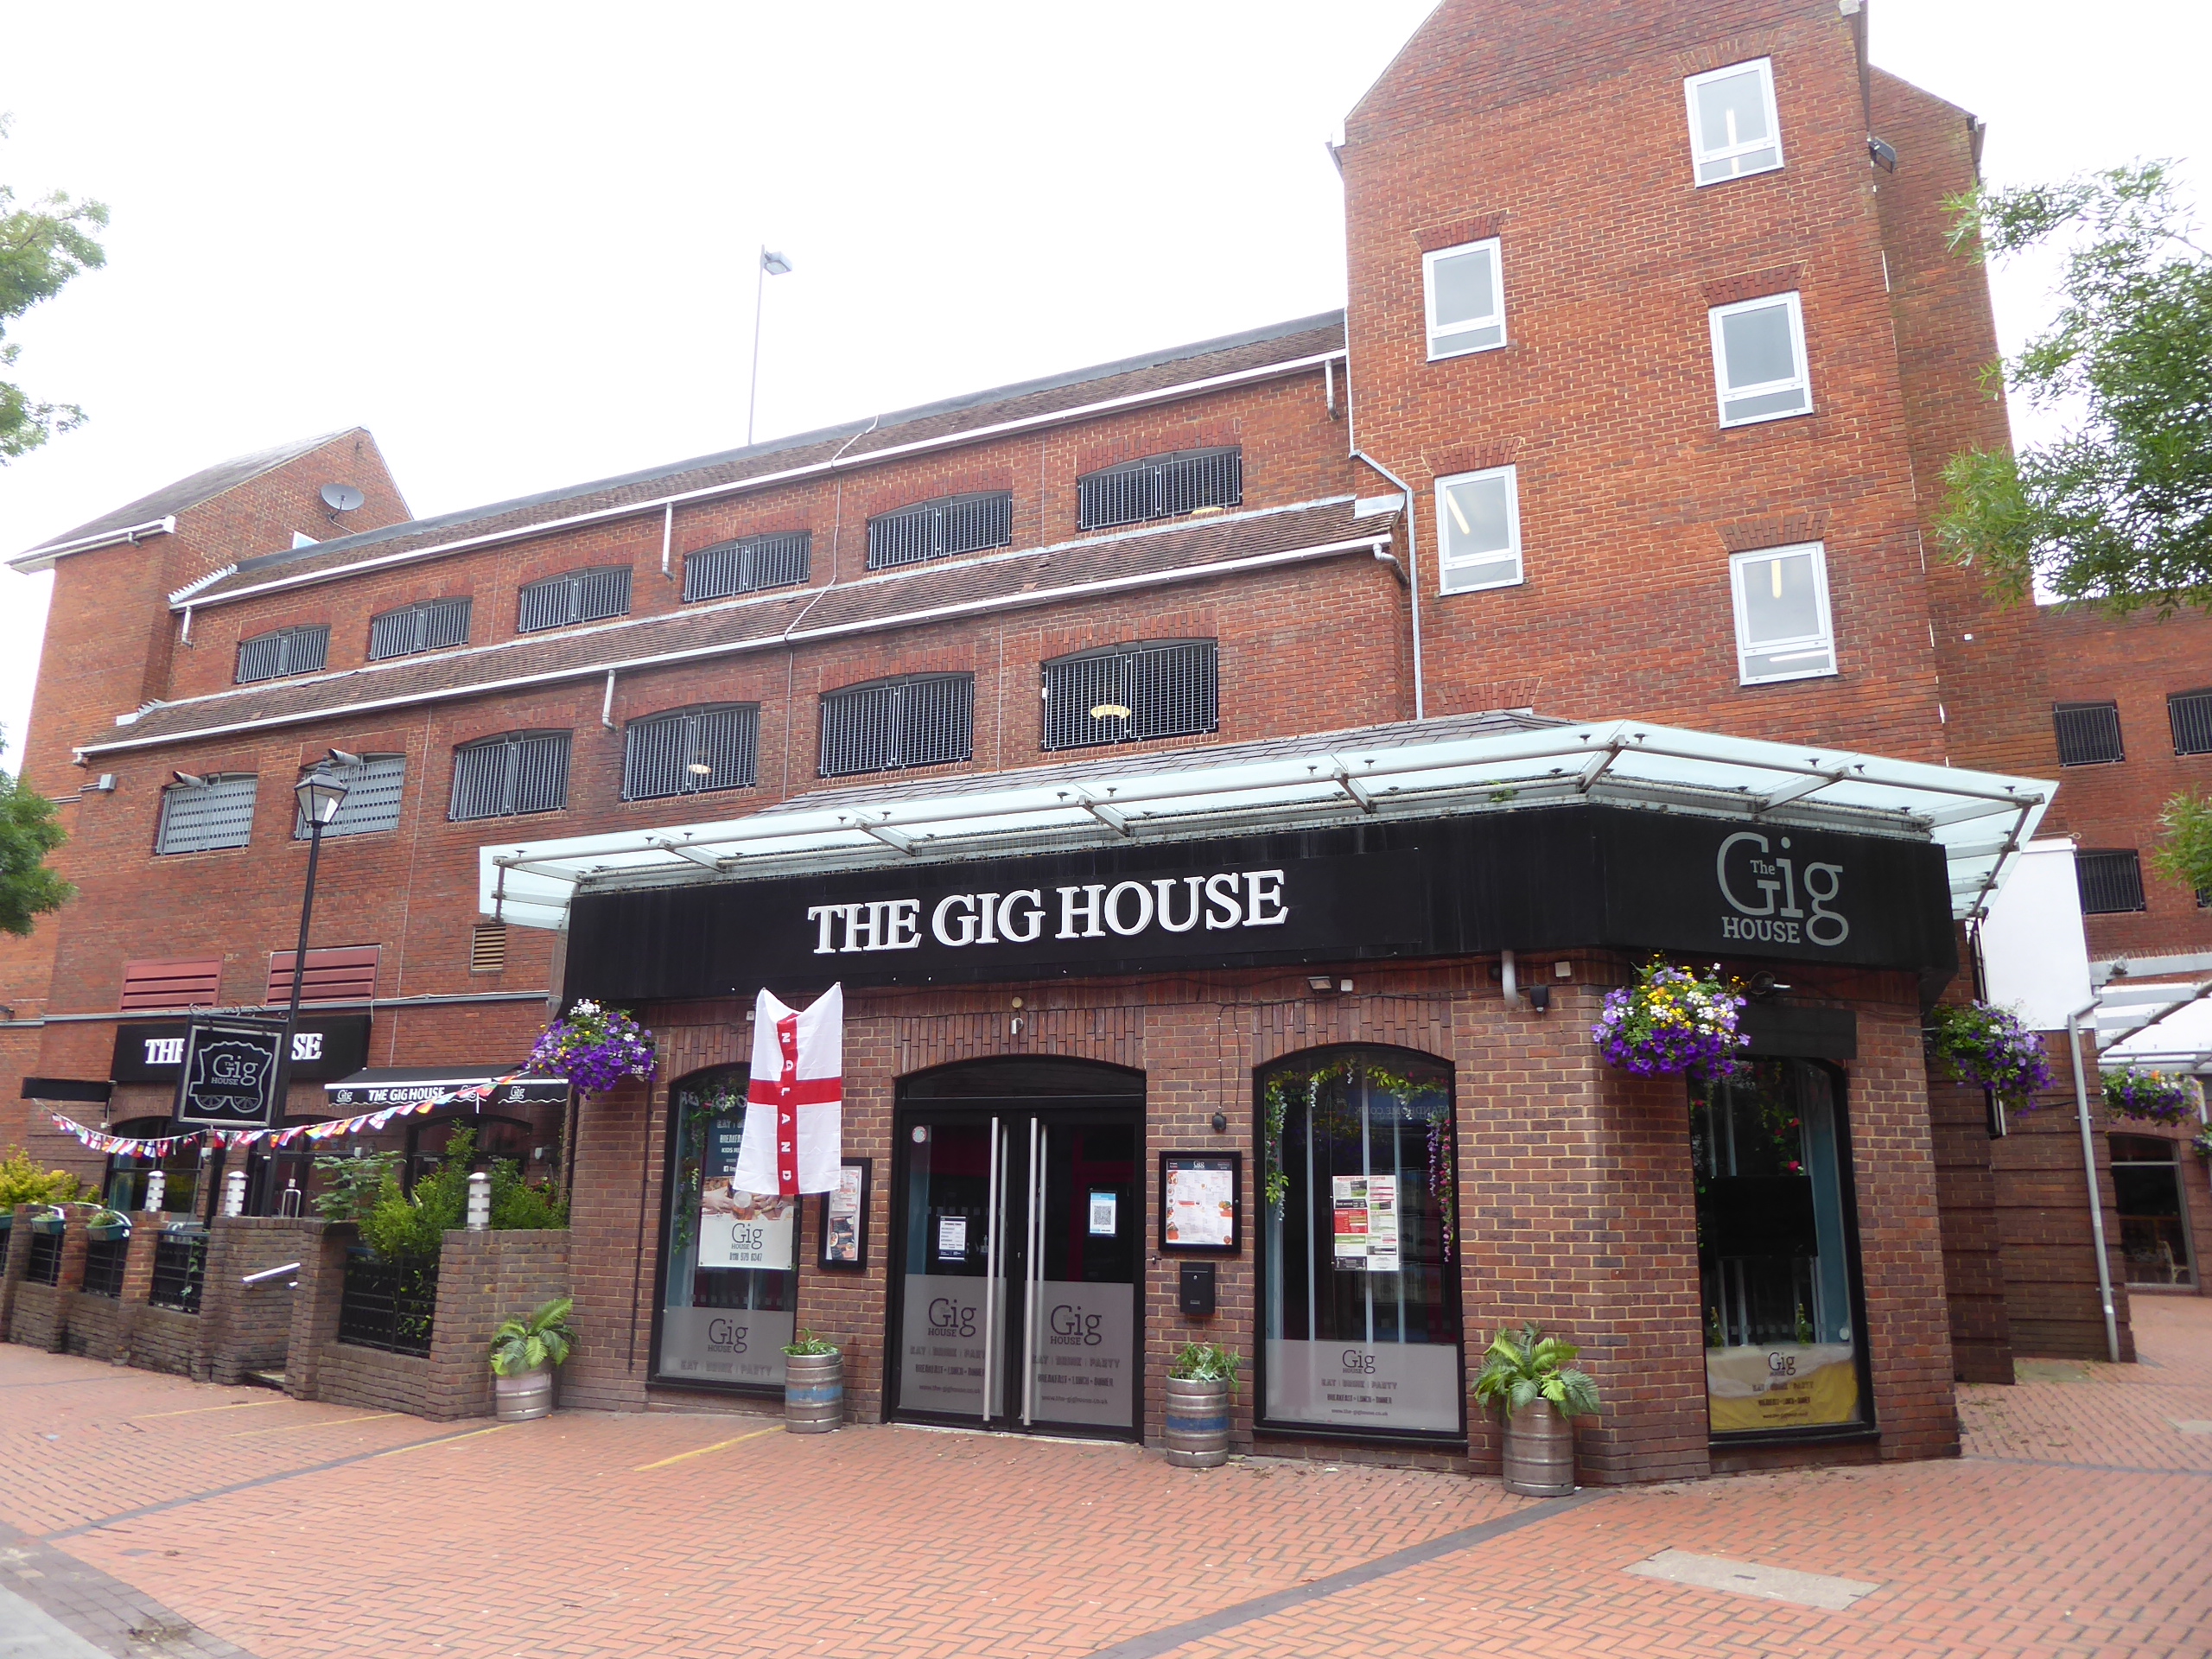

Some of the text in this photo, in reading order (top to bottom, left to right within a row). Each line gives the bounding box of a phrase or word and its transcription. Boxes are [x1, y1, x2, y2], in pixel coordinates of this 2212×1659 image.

[1750, 860, 1776, 875] The
[1717, 831, 1849, 946] Gig
[808, 869, 1288, 954] THE GIG HOUSE
[1721, 916, 1801, 944] HOUSE
[213, 1054, 258, 1086] Gig
[211, 1077, 238, 1085] HOUSE
[337, 1090, 353, 1103] Gig
[368, 1087, 445, 1101] THE GIG HOUSE
[510, 1086, 525, 1099] Gig
[780, 1032, 794, 1181] NGLAND
[720, 1135, 743, 1143] BREAKFA
[732, 1223, 763, 1249] Gig
[928, 1298, 976, 1337] Gig
[1051, 1304, 1102, 1345] Gig
[709, 1319, 748, 1353] Gig
[927, 1328, 957, 1337] HOUSE
[1050, 1336, 1081, 1345] HOUSE
[963, 1349, 985, 1359] PART
[1342, 1350, 1376, 1374] Gig
[681, 1360, 698, 1370] EAT
[741, 1363, 772, 1376] PARTY
[1090, 1357, 1120, 1369] PARTY
[1768, 1352, 1796, 1376] Gig
[1371, 1381, 1397, 1389] PARTY
